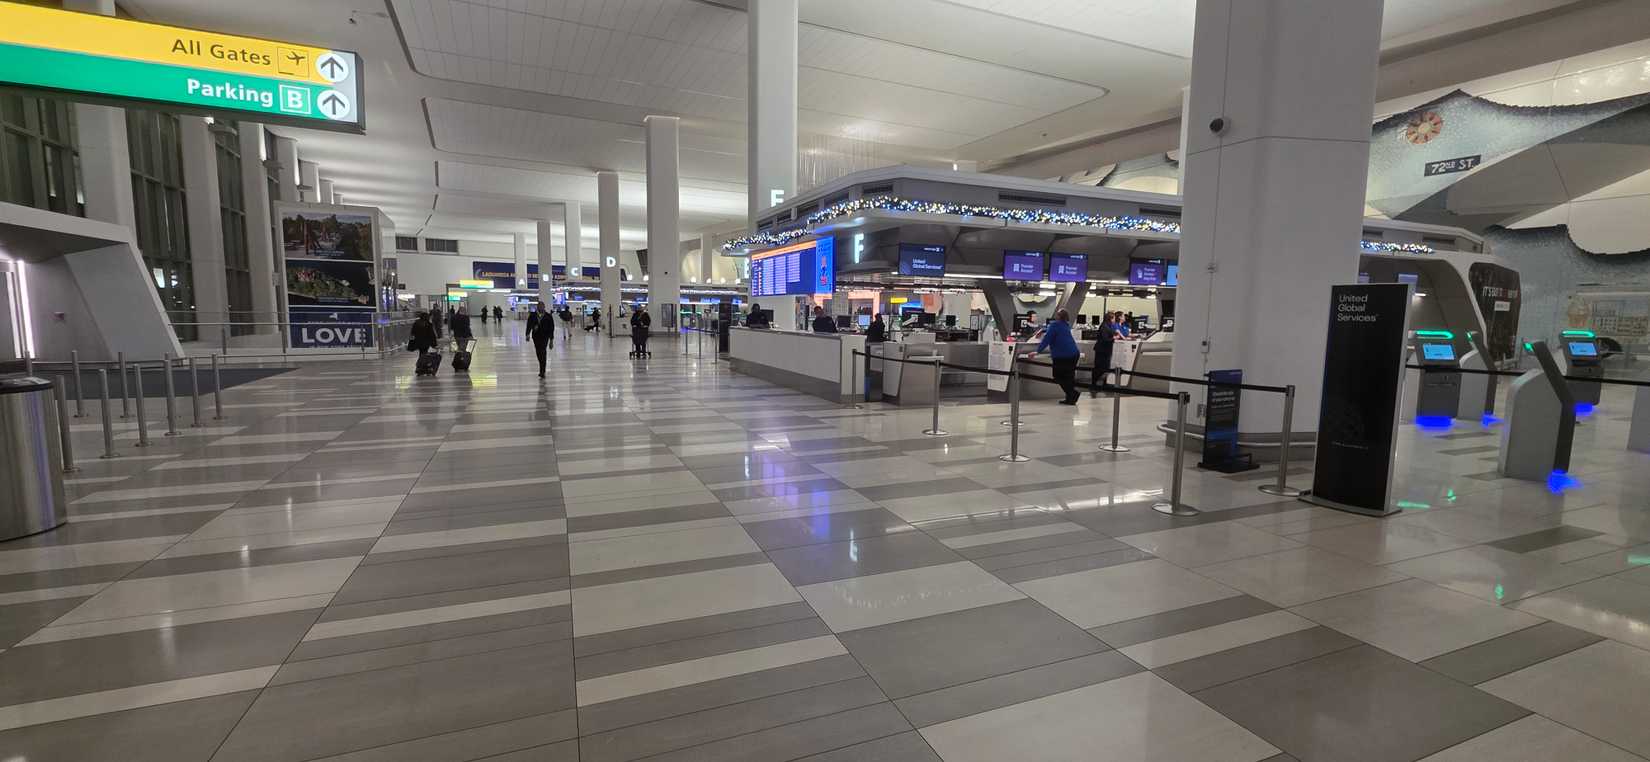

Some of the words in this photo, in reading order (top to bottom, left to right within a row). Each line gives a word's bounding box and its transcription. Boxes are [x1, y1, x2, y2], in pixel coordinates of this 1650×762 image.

[172, 39, 201, 56] All
[210, 44, 271, 66] Gates
[187, 79, 274, 107] Parking
[287, 90, 303, 109] B
[770, 190, 784, 208] F
[854, 233, 864, 264] F
[606, 257, 616, 267] D
[571, 267, 579, 276] C
[1339, 294, 1368, 302] United
[1338, 303, 1366, 312] Global
[1337, 312, 1377, 322] Services
[301, 327, 367, 344] LOVE
